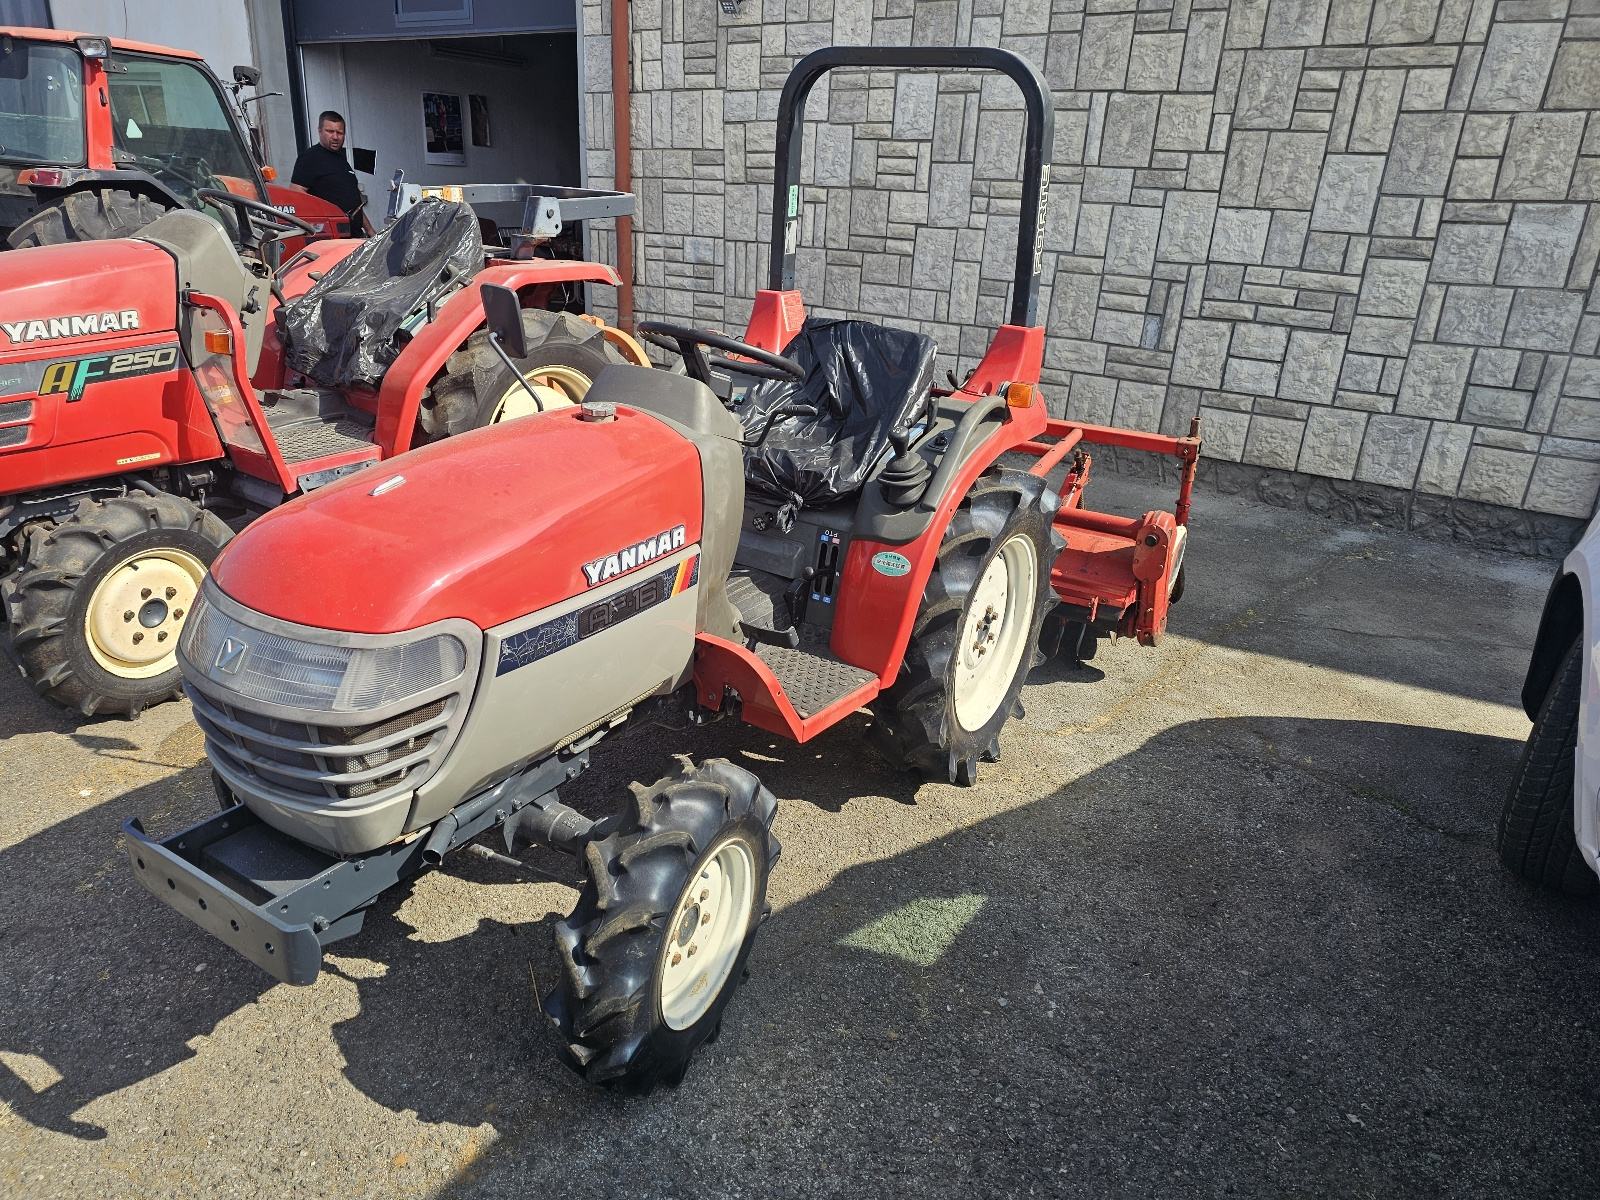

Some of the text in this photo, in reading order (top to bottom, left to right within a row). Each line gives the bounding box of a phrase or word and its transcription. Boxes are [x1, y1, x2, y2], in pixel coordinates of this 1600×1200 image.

[1, 310, 140, 343] YANMAR
[39, 347, 177, 401] AF 250
[581, 524, 685, 587] YANMAR
